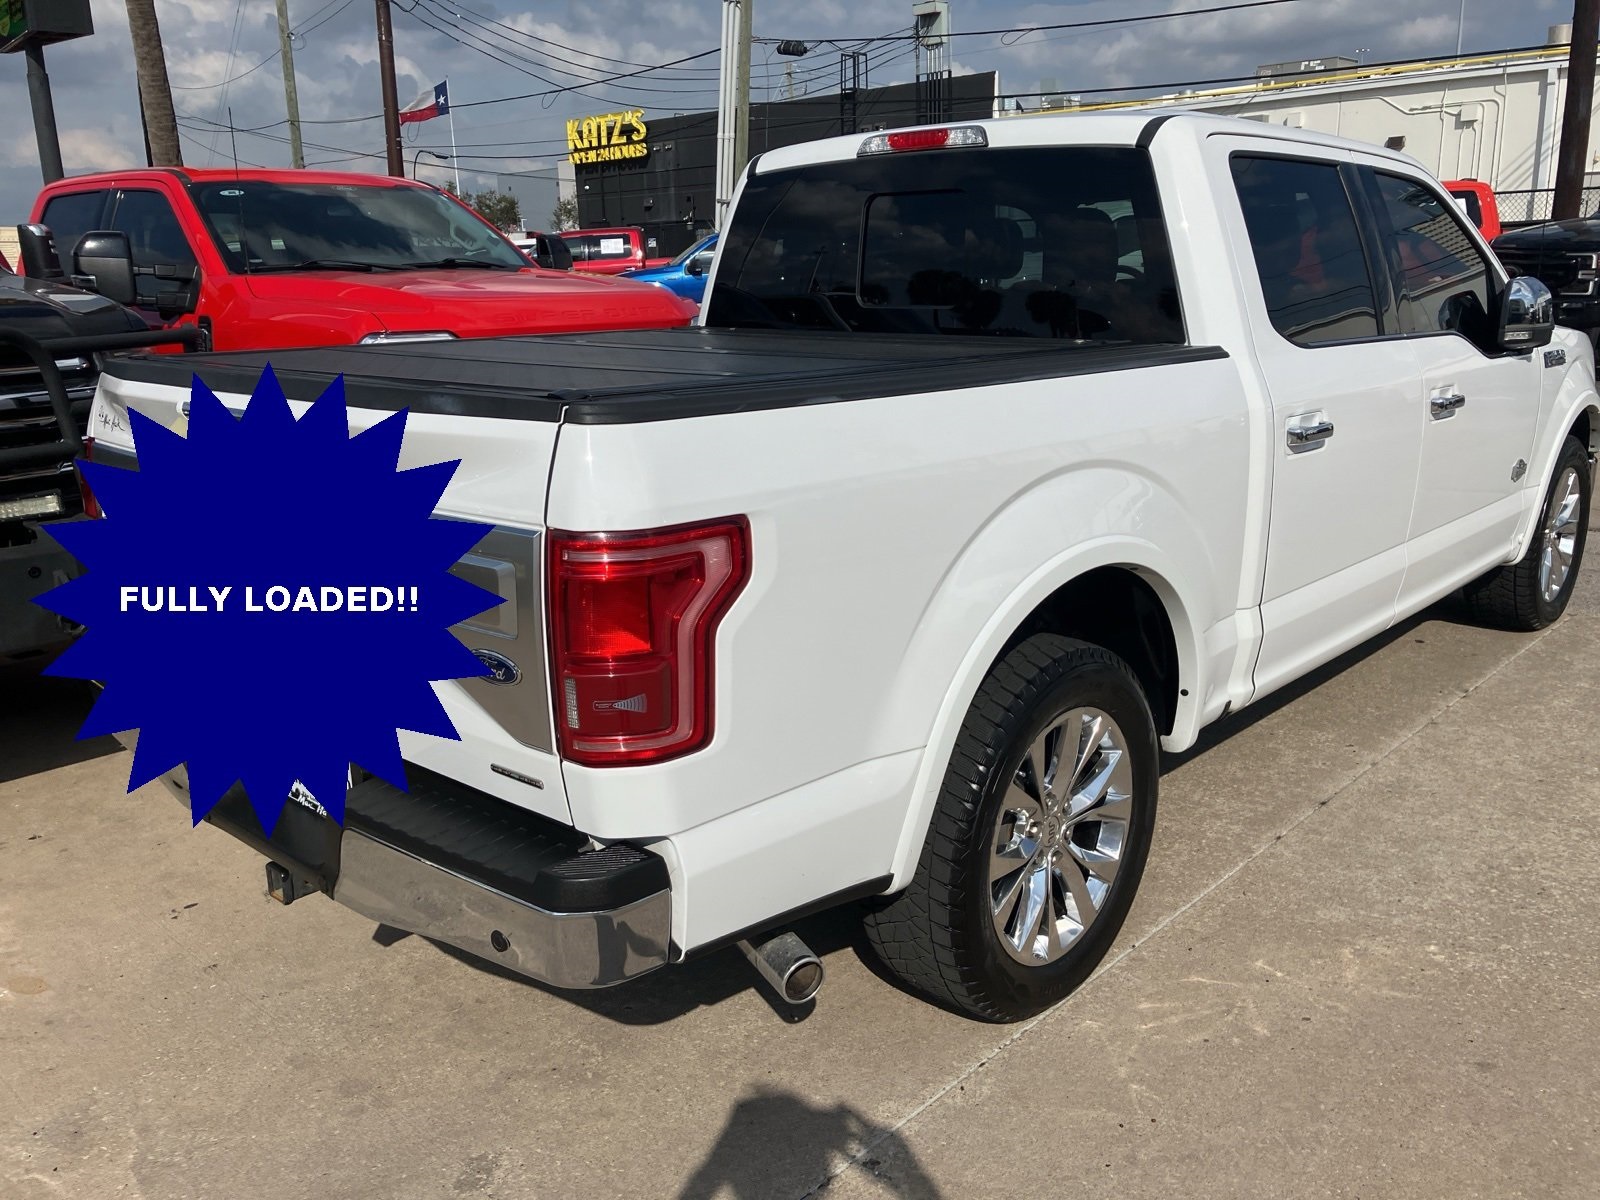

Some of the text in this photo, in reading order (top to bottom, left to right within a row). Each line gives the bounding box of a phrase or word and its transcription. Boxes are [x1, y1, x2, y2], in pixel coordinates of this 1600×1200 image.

[566, 109, 647, 150] KATZ'S
[569, 149, 597, 165] OPEN
[610, 142, 648, 160] HOURS
